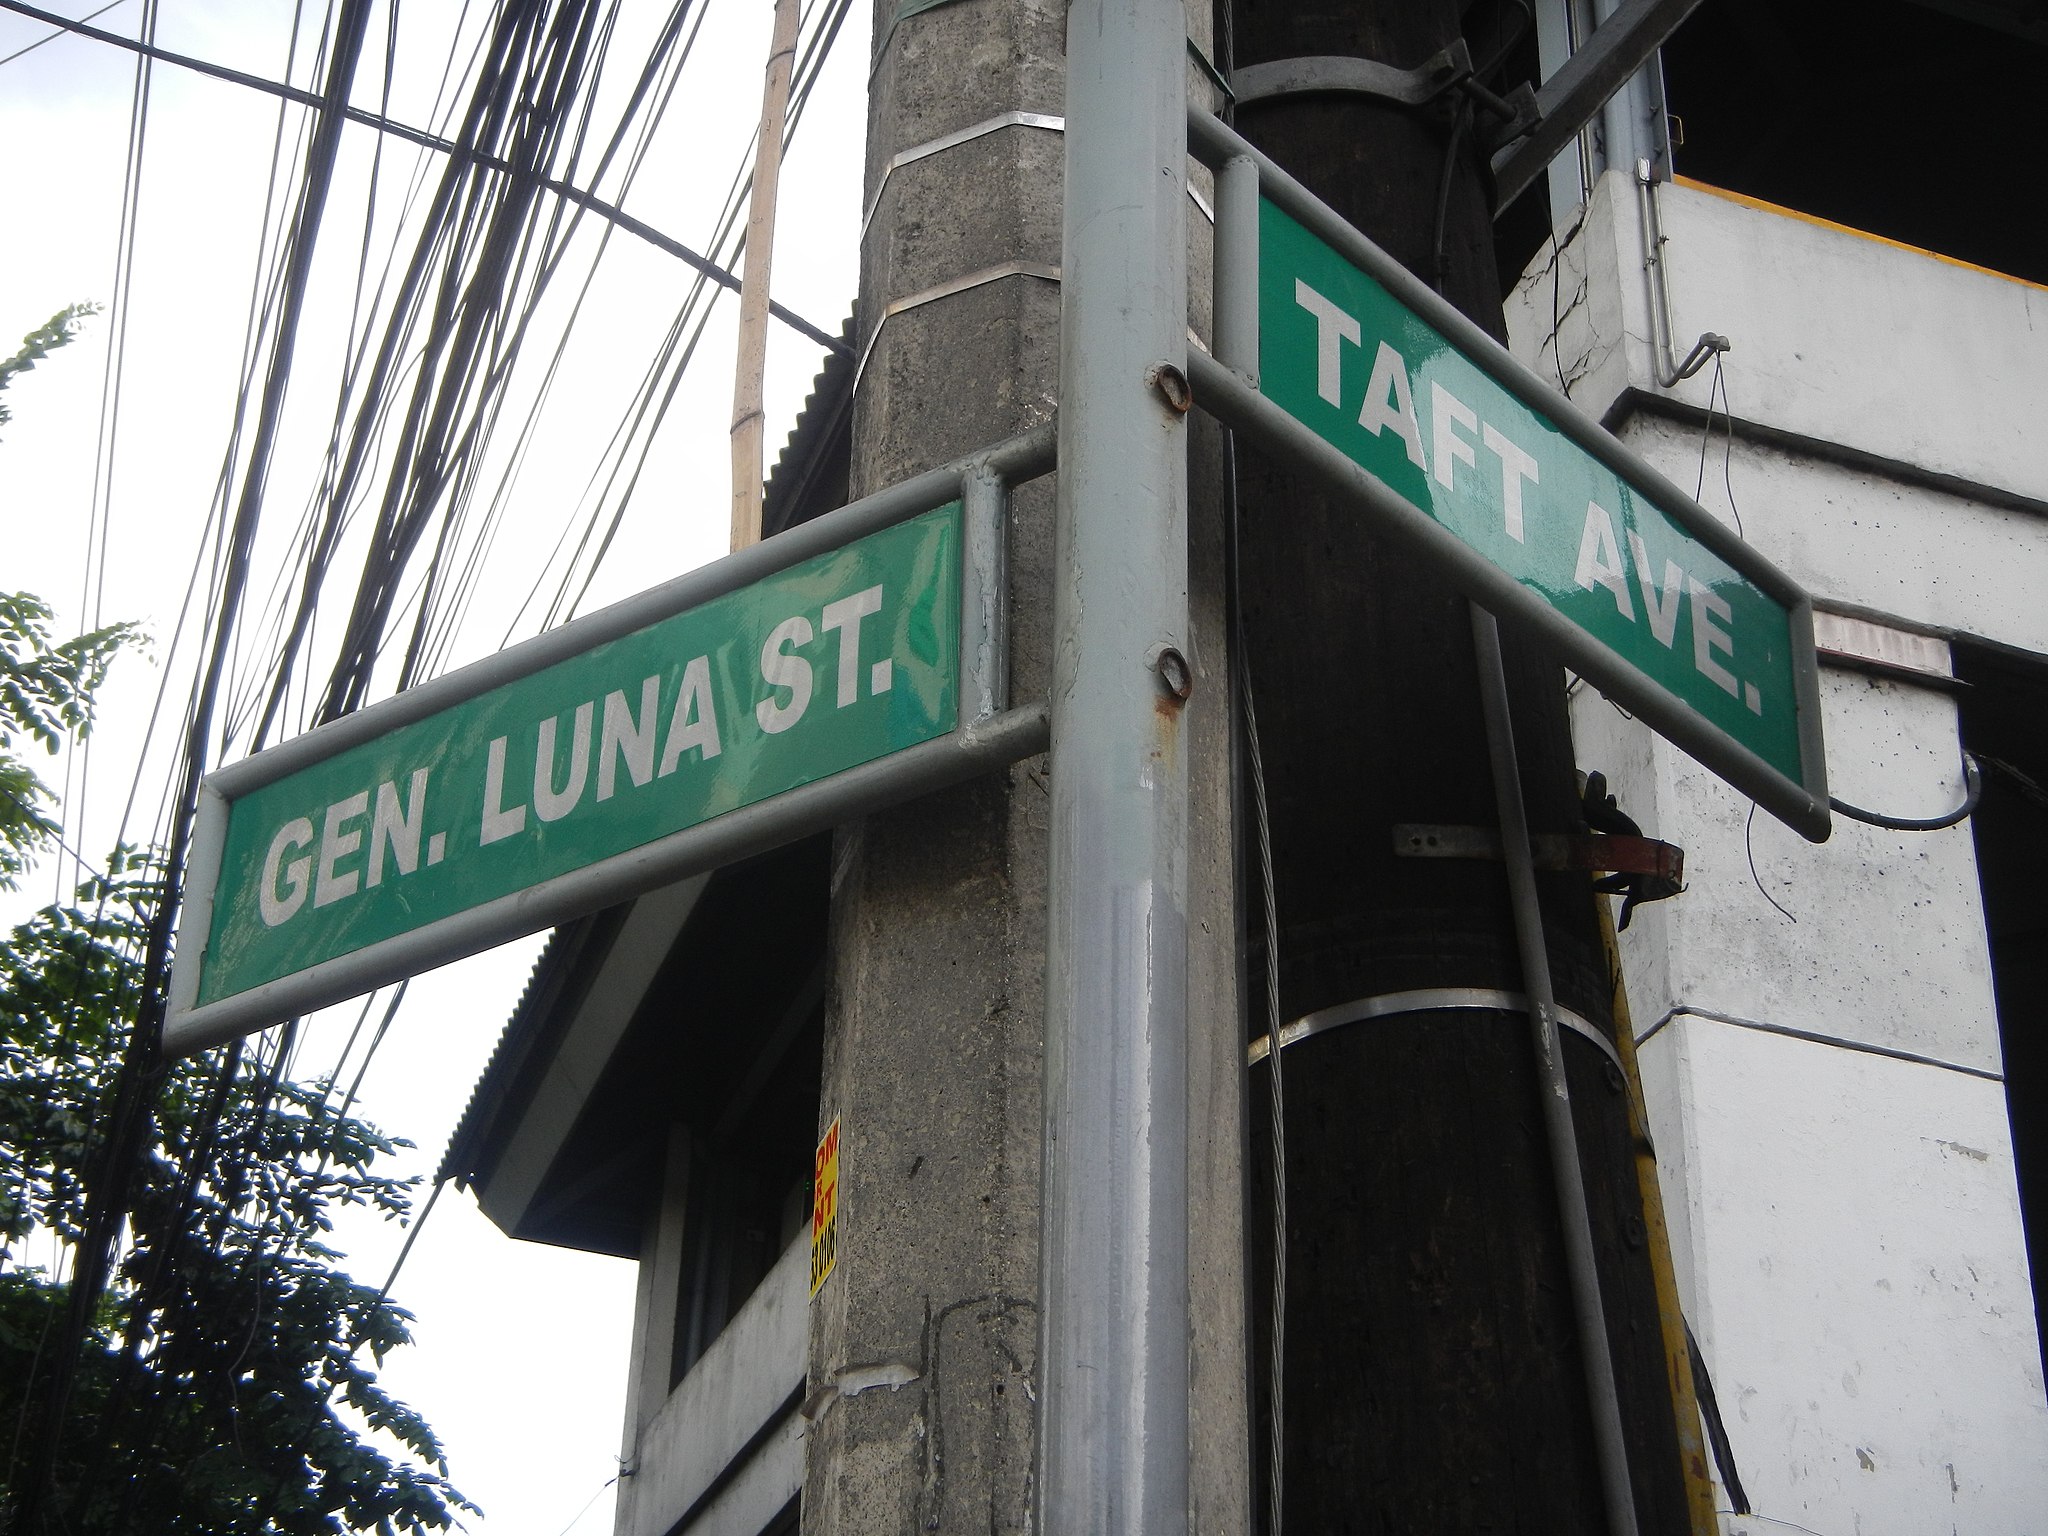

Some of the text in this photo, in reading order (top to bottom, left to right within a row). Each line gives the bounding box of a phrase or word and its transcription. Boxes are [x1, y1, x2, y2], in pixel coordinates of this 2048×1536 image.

[1295, 277, 1762, 717] TAFT AVE.
[258, 583, 892, 927] GEN. LUNA ST.
